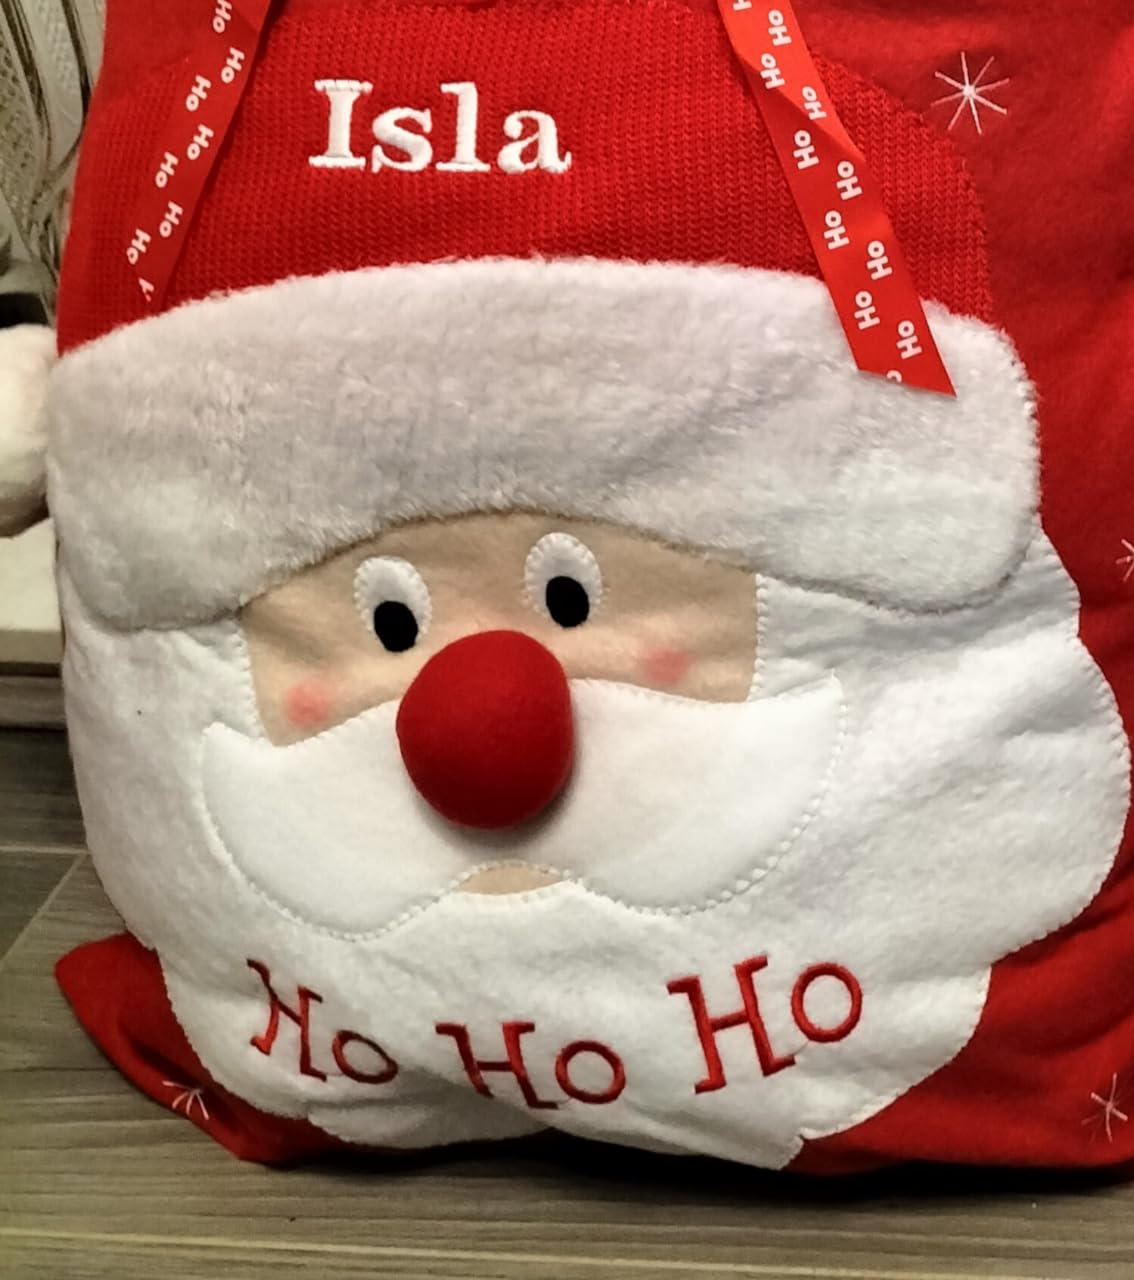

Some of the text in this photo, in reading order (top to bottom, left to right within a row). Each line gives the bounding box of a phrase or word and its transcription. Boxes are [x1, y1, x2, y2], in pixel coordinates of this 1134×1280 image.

[769, 10, 791, 45] Ho
[221, 48, 244, 83] Ho
[761, 54, 784, 88] Ho
[186, 76, 211, 111] Ho
[803, 87, 826, 119] Ho
[188, 125, 213, 159] Ho
[309, 80, 571, 173] Isla
[794, 131, 819, 169] Ho
[156, 152, 178, 187] Ho
[837, 161, 862, 199] Ho
[160, 202, 182, 237] Ho
[824, 211, 849, 249] Ho
[127, 229, 150, 264] Ho
[867, 241, 892, 279] Ho
[855, 292, 880, 329] Ho
[897, 321, 921, 359] Ho
[245, 954, 864, 1110] Ho Ho Ho
